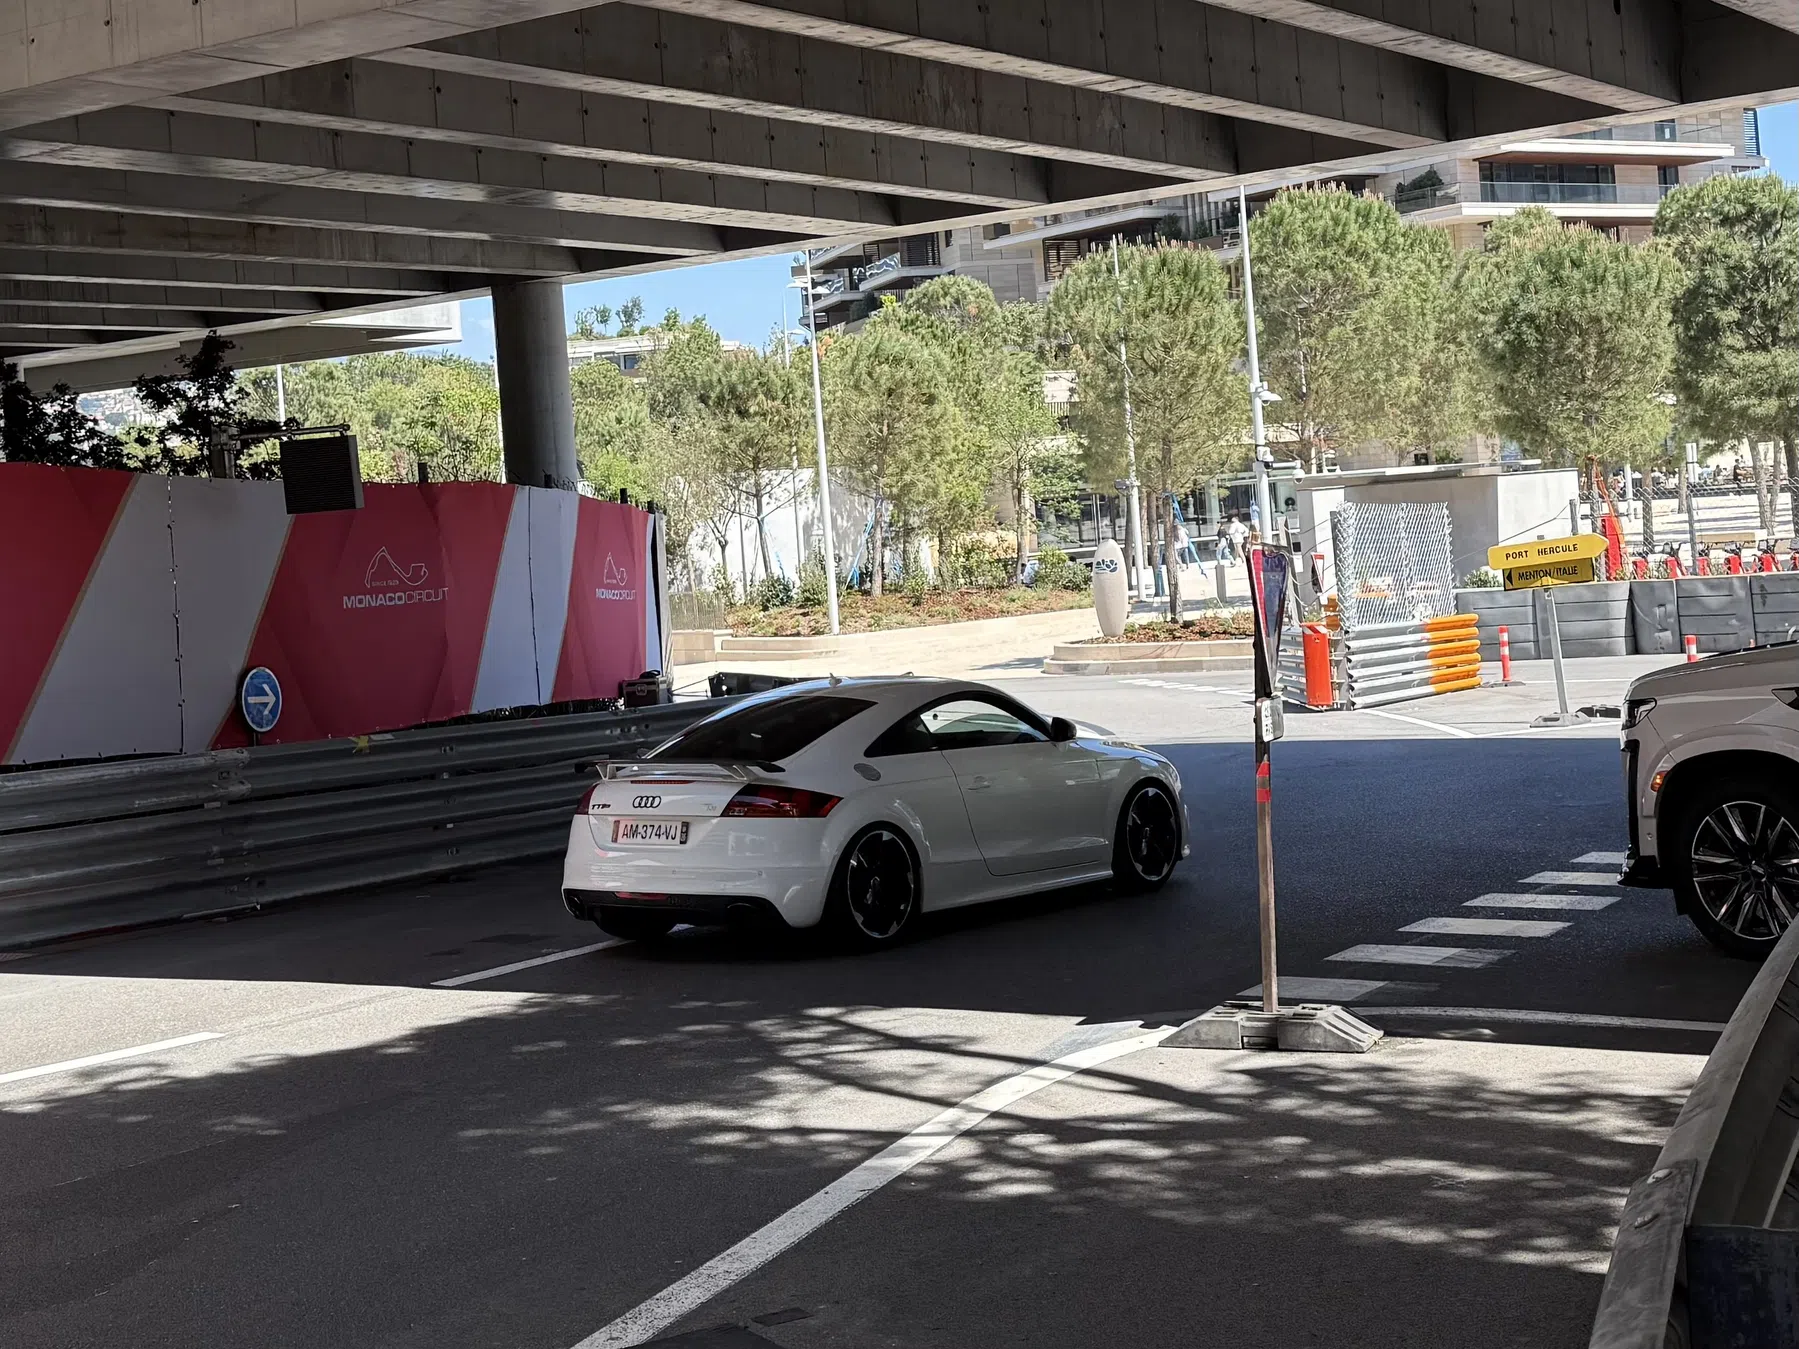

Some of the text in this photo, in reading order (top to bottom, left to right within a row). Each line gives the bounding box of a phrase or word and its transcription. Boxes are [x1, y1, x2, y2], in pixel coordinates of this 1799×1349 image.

[1505, 543, 1579, 561] PORT HERCULE
[621, 824, 678, 841] AM-374-VJ
